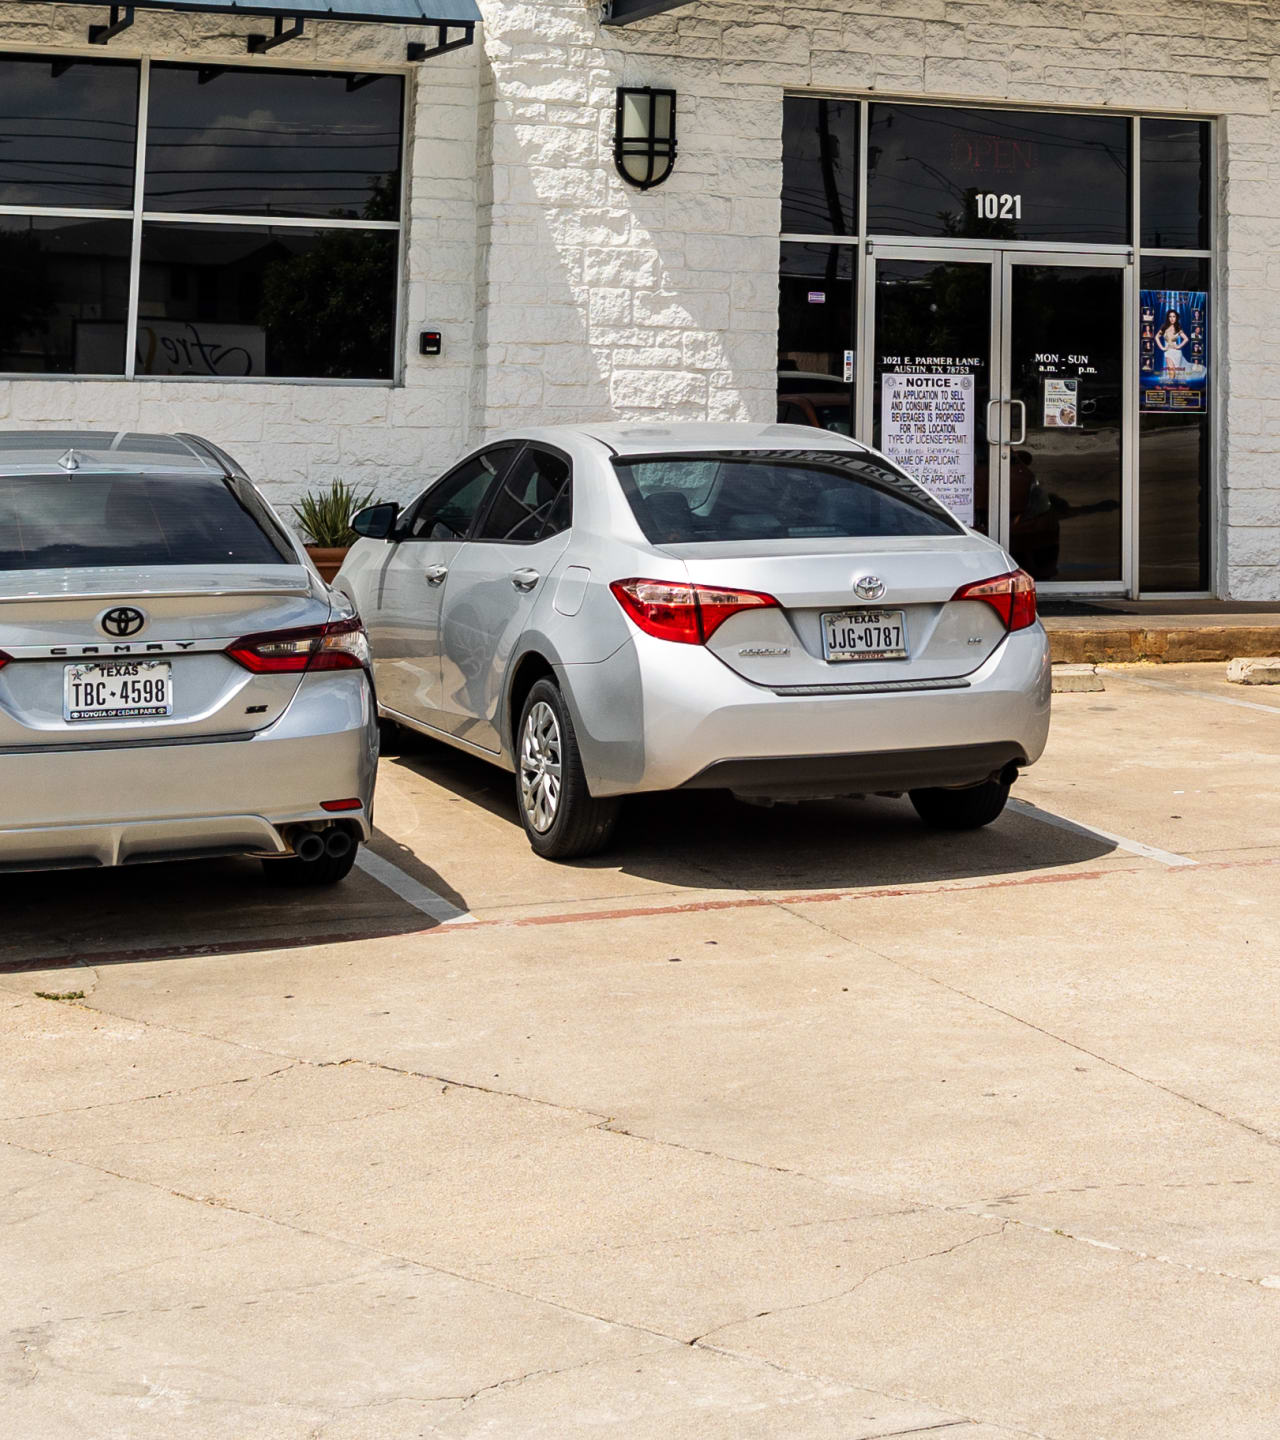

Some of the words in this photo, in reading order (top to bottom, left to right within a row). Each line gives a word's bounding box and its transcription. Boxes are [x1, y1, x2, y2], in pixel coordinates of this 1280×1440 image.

[955, 143, 1032, 169] OPEN
[975, 193, 1022, 219] 1021
[882, 356, 901, 365] 1021
[915, 357, 953, 366] PARMER
[1035, 353, 1059, 363] MON
[1067, 354, 1089, 364] SUN
[931, 366, 944, 374] TX
[946, 366, 970, 374] 78753
[906, 377, 951, 388] NOTICE
[893, 390, 901, 400] AN
[903, 390, 938, 400] APPLICATION
[941, 390, 949, 400] TO
[950, 390, 964, 401] SELL
[890, 401, 903, 411] AND
[905, 401, 932, 412] CONSUME
[934, 402, 966, 412] ALCOHOLIC
[891, 412, 925, 422] BEVERAGES
[927, 413, 933, 422] IS
[935, 413, 965, 423] PROPOSED
[899, 424, 912, 434] FOR
[914, 424, 926, 434] THIS
[888, 435, 904, 444] TYPE
[906, 435, 915, 444] OF
[895, 456, 913, 465] NAME
[914, 456, 924, 465] OF
[921, 475, 930, 485] OF
[847, 615, 880, 625] TEXAS
[50, 642, 195, 655] CAMRY
[99, 665, 139, 678] TEXAS
